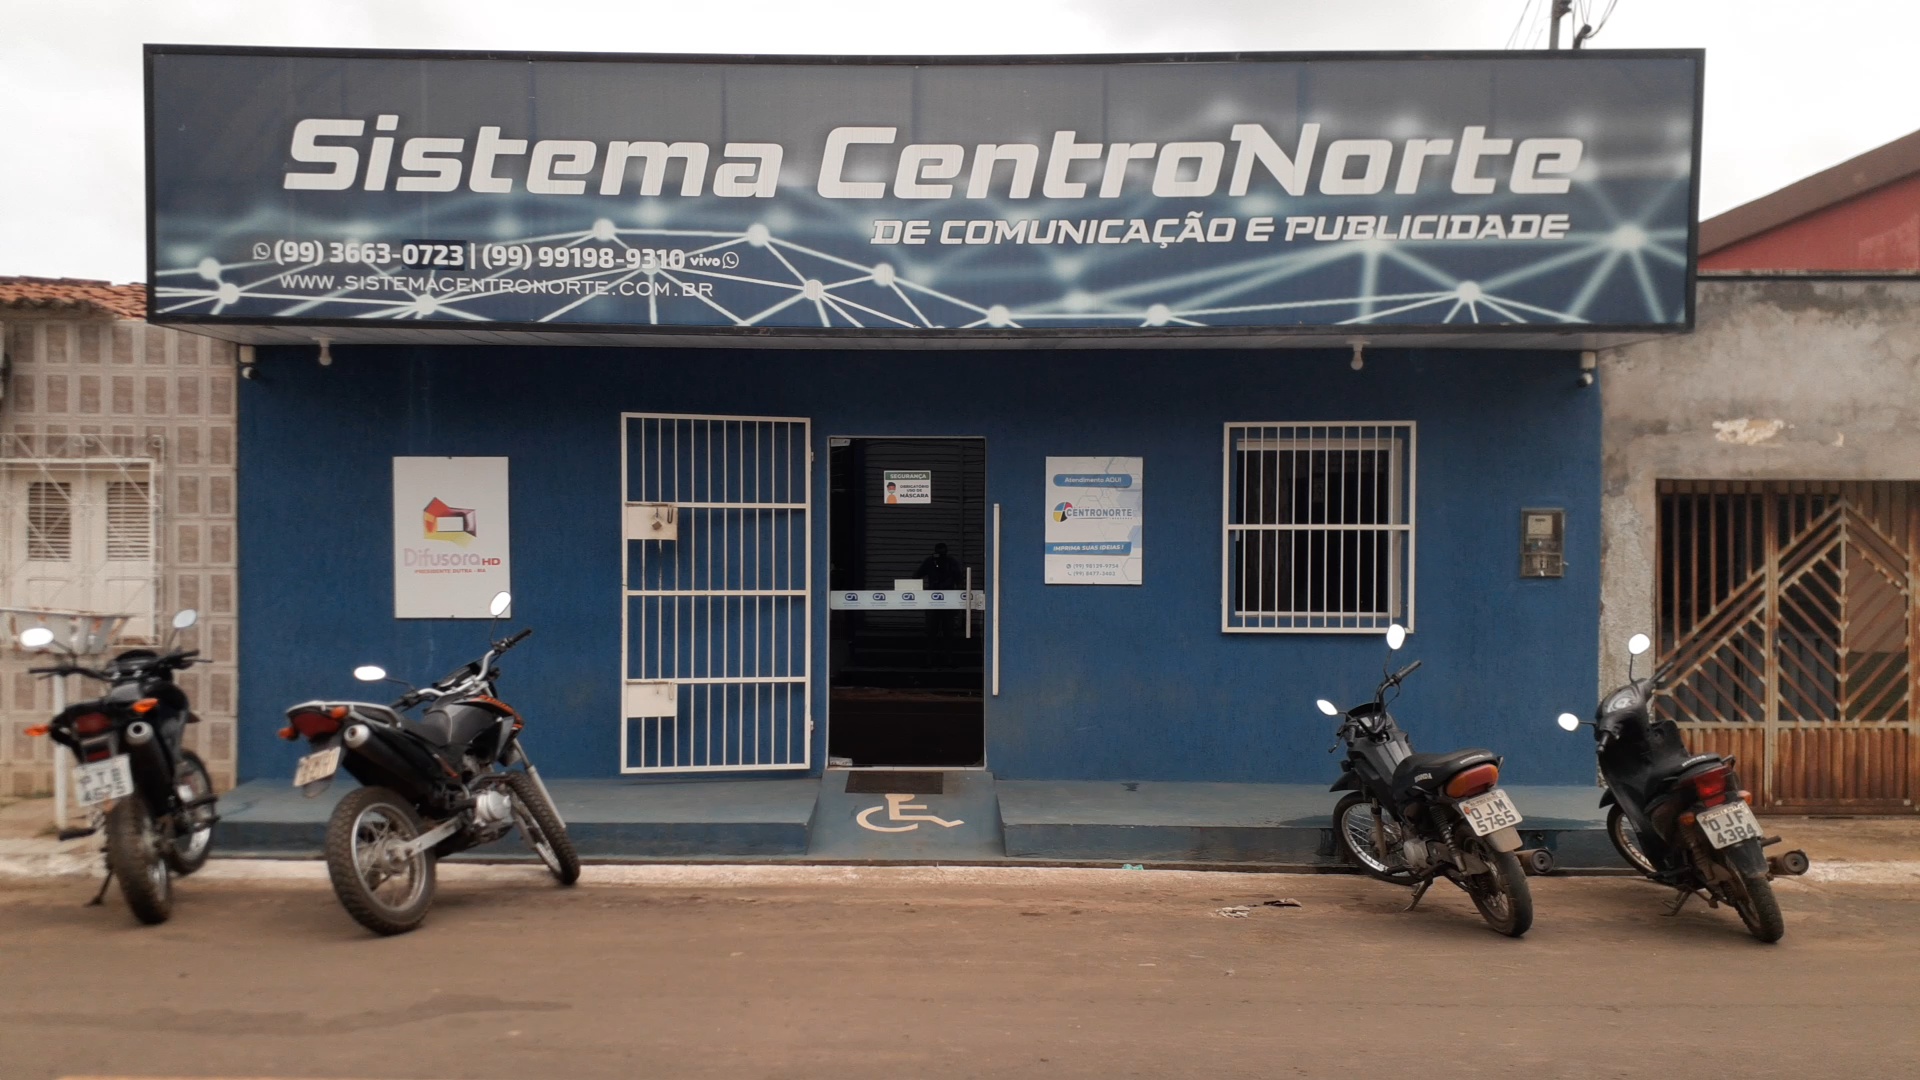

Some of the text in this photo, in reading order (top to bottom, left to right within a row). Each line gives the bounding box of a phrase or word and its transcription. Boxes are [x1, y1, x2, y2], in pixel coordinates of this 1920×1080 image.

[283, 114, 1585, 199] Sistema CentroNorte
[870, 211, 1571, 249] DE COMUNICAÇÃO E PUBLICIDADE
[274, 239, 324, 266] (99)
[329, 242, 464, 266] 3663-0723
[482, 245, 532, 270] (99)
[538, 246, 686, 270] 99198-9310
[690, 255, 721, 267] vivo
[280, 273, 714, 298] WWW.SISTEMACENTRONORTE.COM.BR
[1066, 508, 1133, 517] CENTRONORTE
[403, 548, 501, 567] Difusora HD
